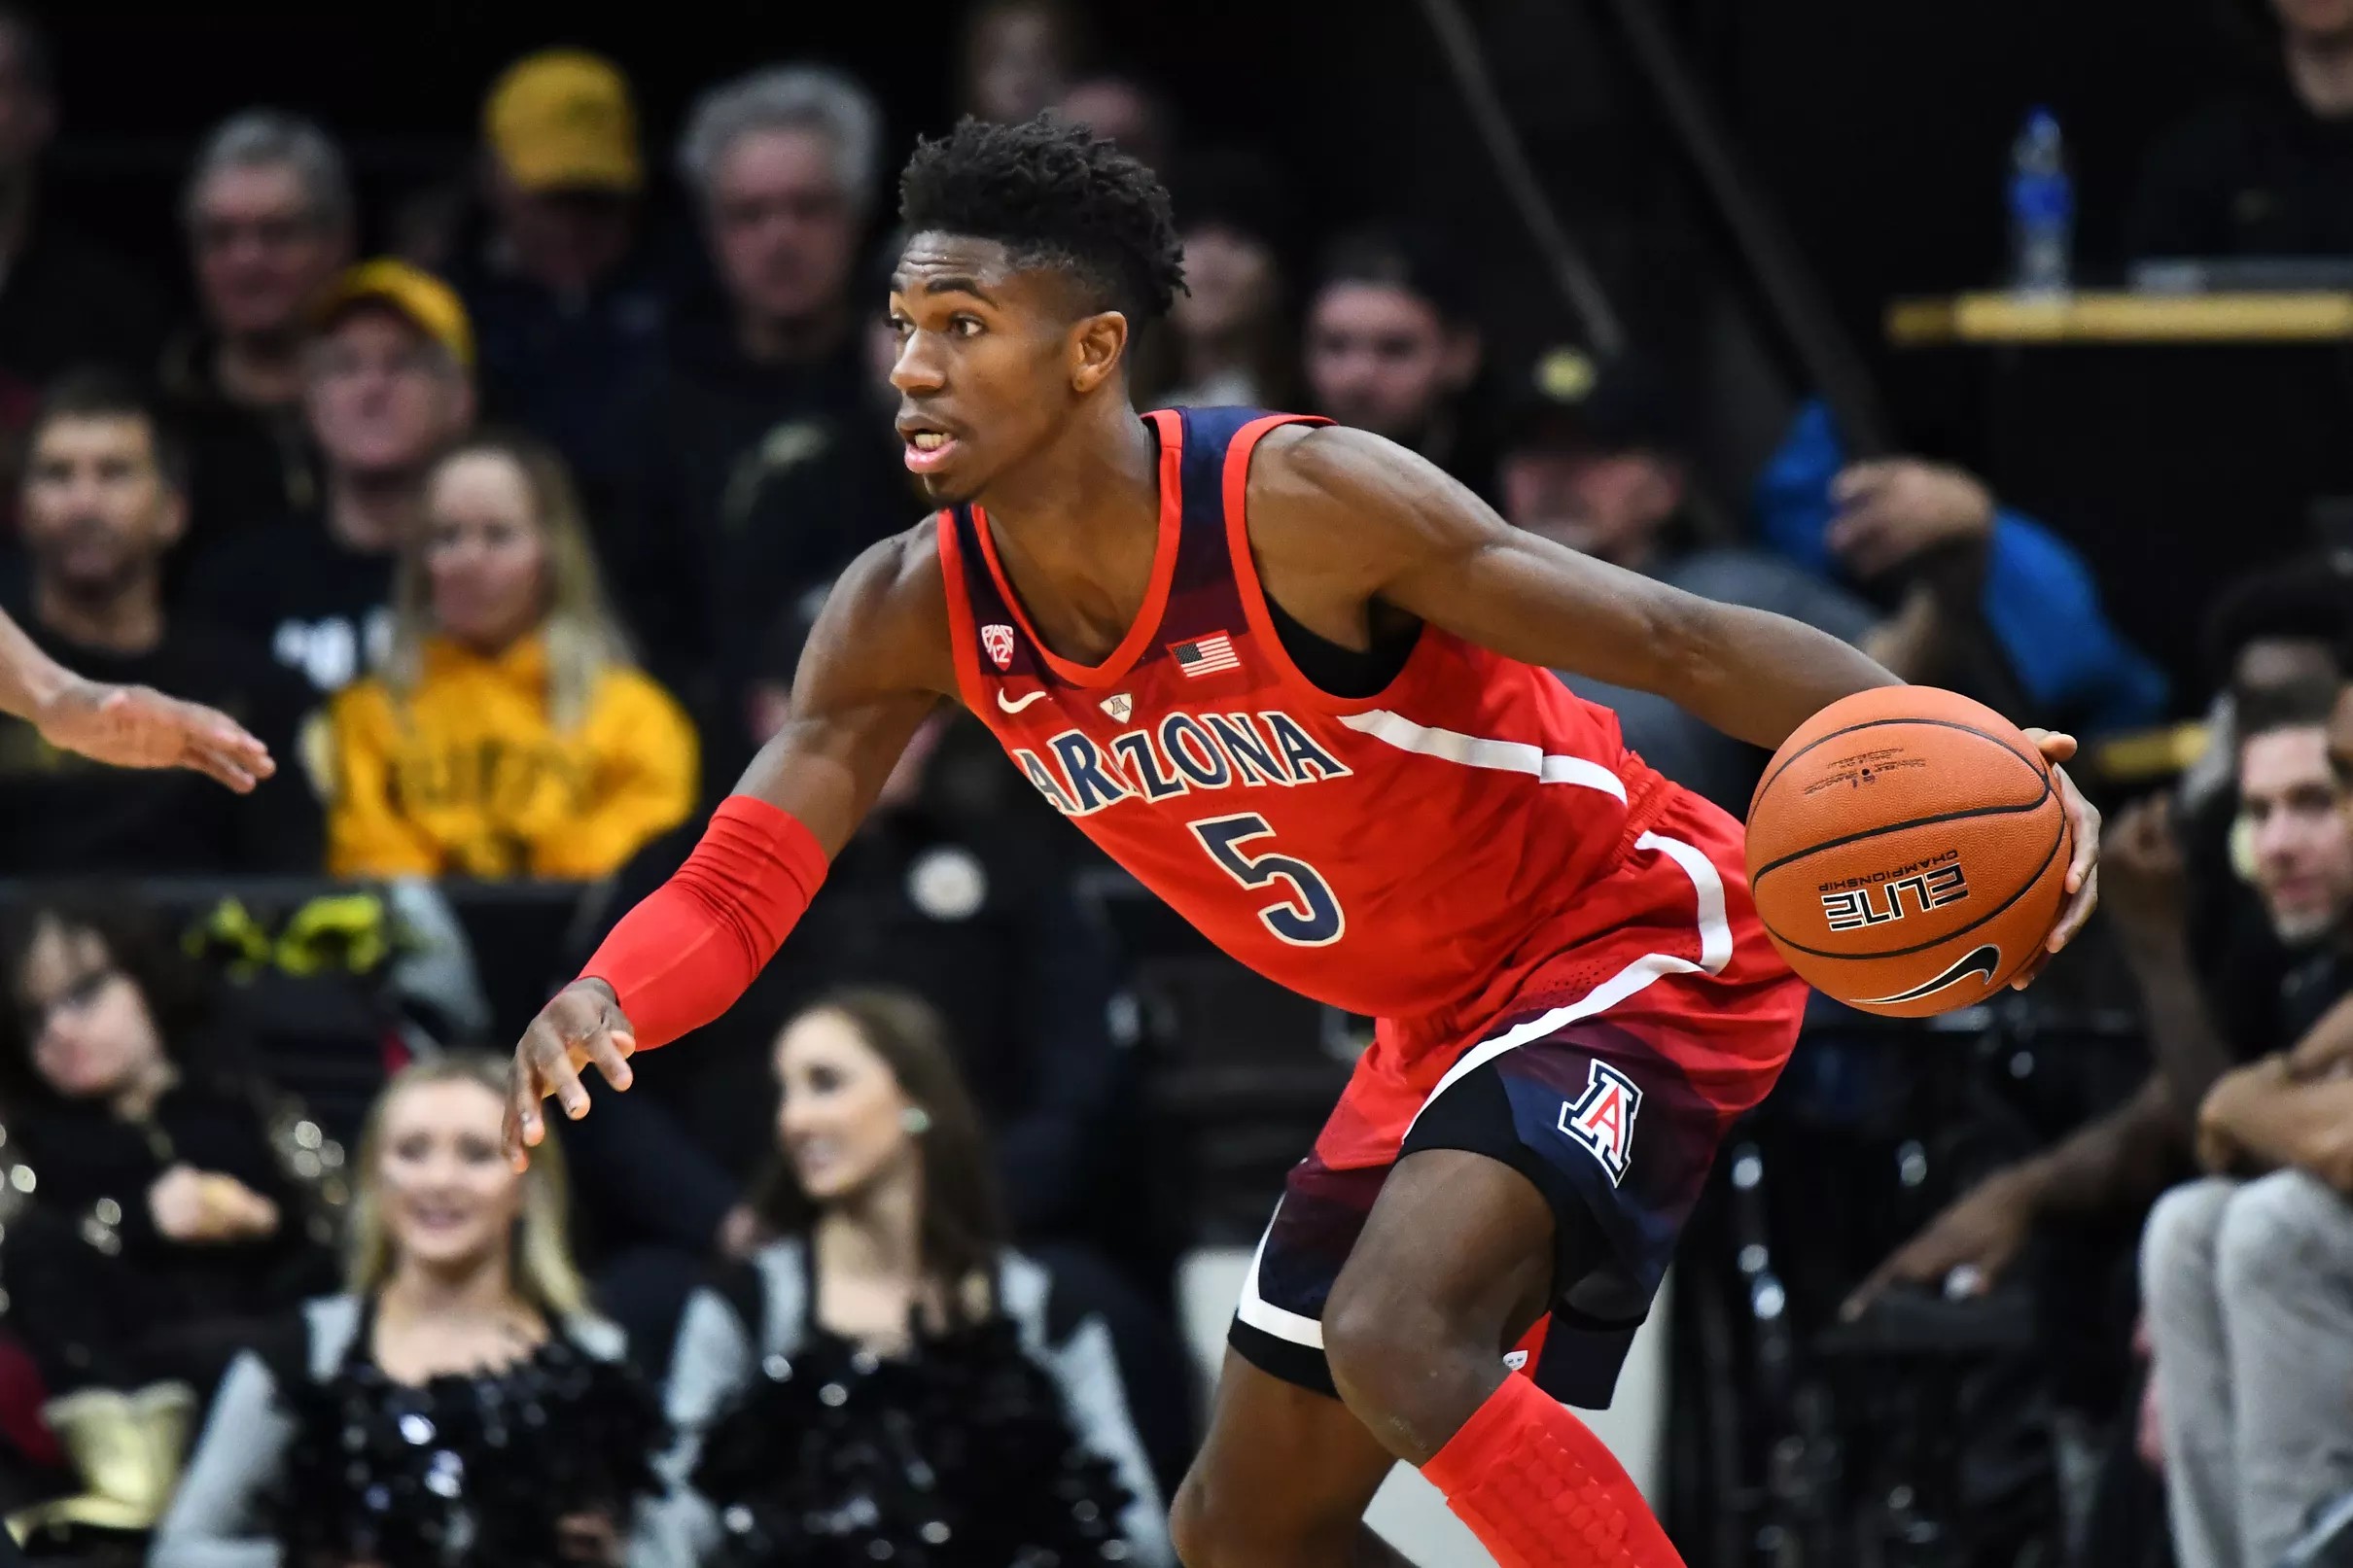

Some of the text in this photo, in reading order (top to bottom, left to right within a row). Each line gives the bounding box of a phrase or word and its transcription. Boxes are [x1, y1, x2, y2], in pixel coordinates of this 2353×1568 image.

[1110, 697, 1130, 715] A
[1013, 712, 1353, 817] ARZONA
[1185, 812, 1346, 947] 5
[1818, 850, 1958, 892] CHAMPIONSHIP
[1821, 863, 1969, 931] ELITE
[1557, 1058, 1643, 1189] A
